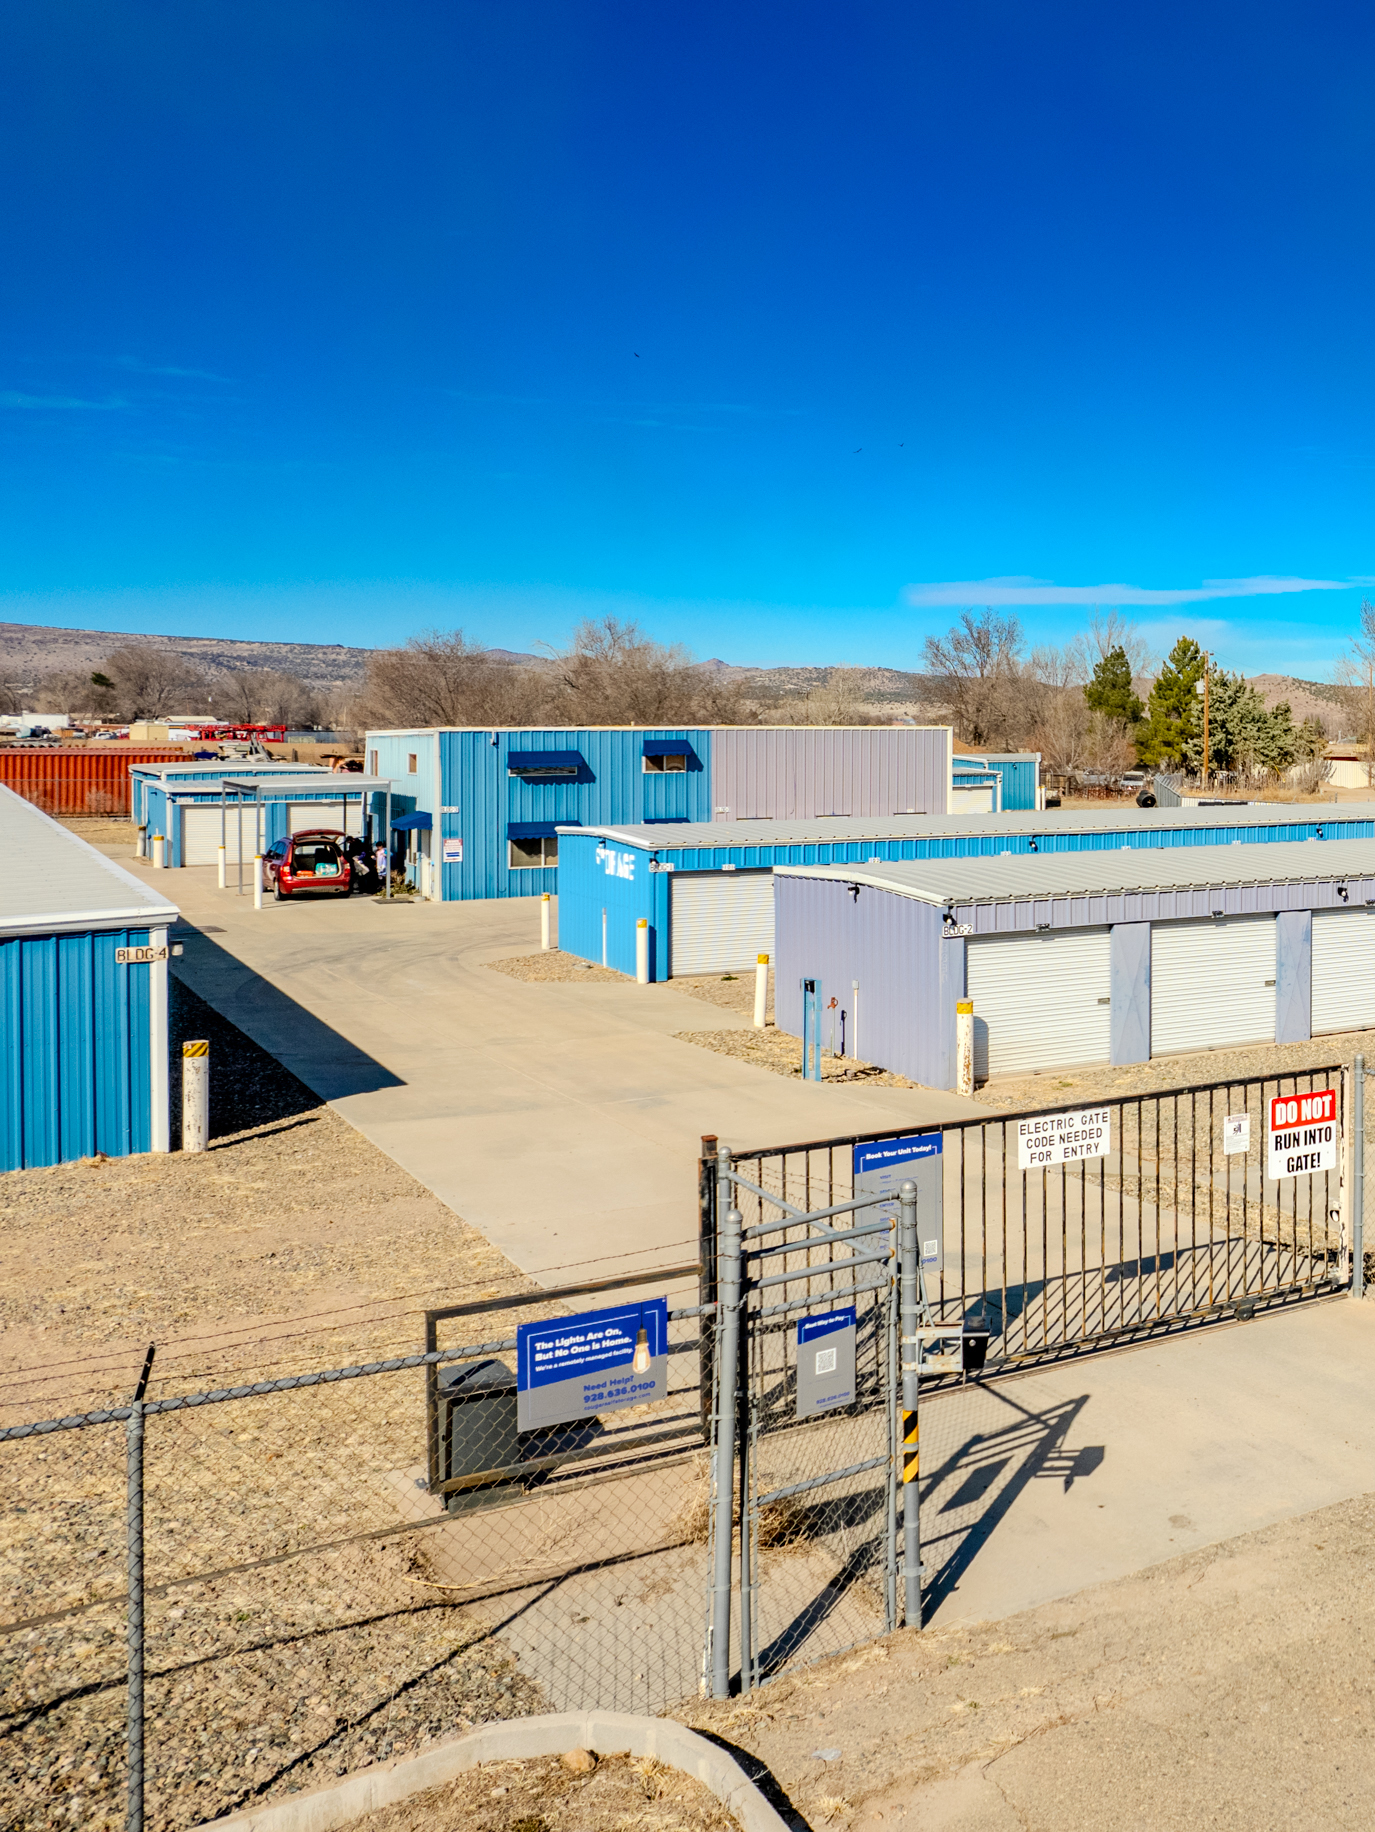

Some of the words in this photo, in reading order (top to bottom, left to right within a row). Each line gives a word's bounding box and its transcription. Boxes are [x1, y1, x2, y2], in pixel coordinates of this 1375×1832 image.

[943, 924, 973, 936] BLDG-2
[117, 947, 167, 961] BLDG-4
[1275, 1100, 1298, 1126] DO
[1301, 1095, 1332, 1121] NOT
[1020, 1117, 1075, 1135] ELECTRIC
[1081, 1112, 1108, 1126] GATE
[1026, 1135, 1055, 1149] CODE
[1059, 1127, 1103, 1144] NEEDED
[1274, 1131, 1300, 1151] RUN
[1304, 1126, 1332, 1146] INTO
[866, 1151, 882, 1160] Book
[1030, 1150, 1052, 1164] FOR
[1063, 1142, 1100, 1158] ENTRY
[1287, 1152, 1320, 1173] GATE!
[534, 1341, 554, 1351] The
[555, 1335, 585, 1347] Lights
[586, 1332, 604, 1341] Are
[605, 1328, 622, 1337] On,
[535, 1351, 554, 1362] But
[555, 1348, 569, 1357] No
[570, 1344, 590, 1354] One
[592, 1341, 600, 1350] is
[601, 1337, 632, 1348] Home.
[535, 1363, 553, 1372] We're
[558, 1357, 585, 1367] remotely
[585, 1351, 612, 1361] managed
[583, 1381, 607, 1392] Need
[609, 1375, 634, 1387] Help?
[583, 1380, 656, 1403] 928.636.0100
